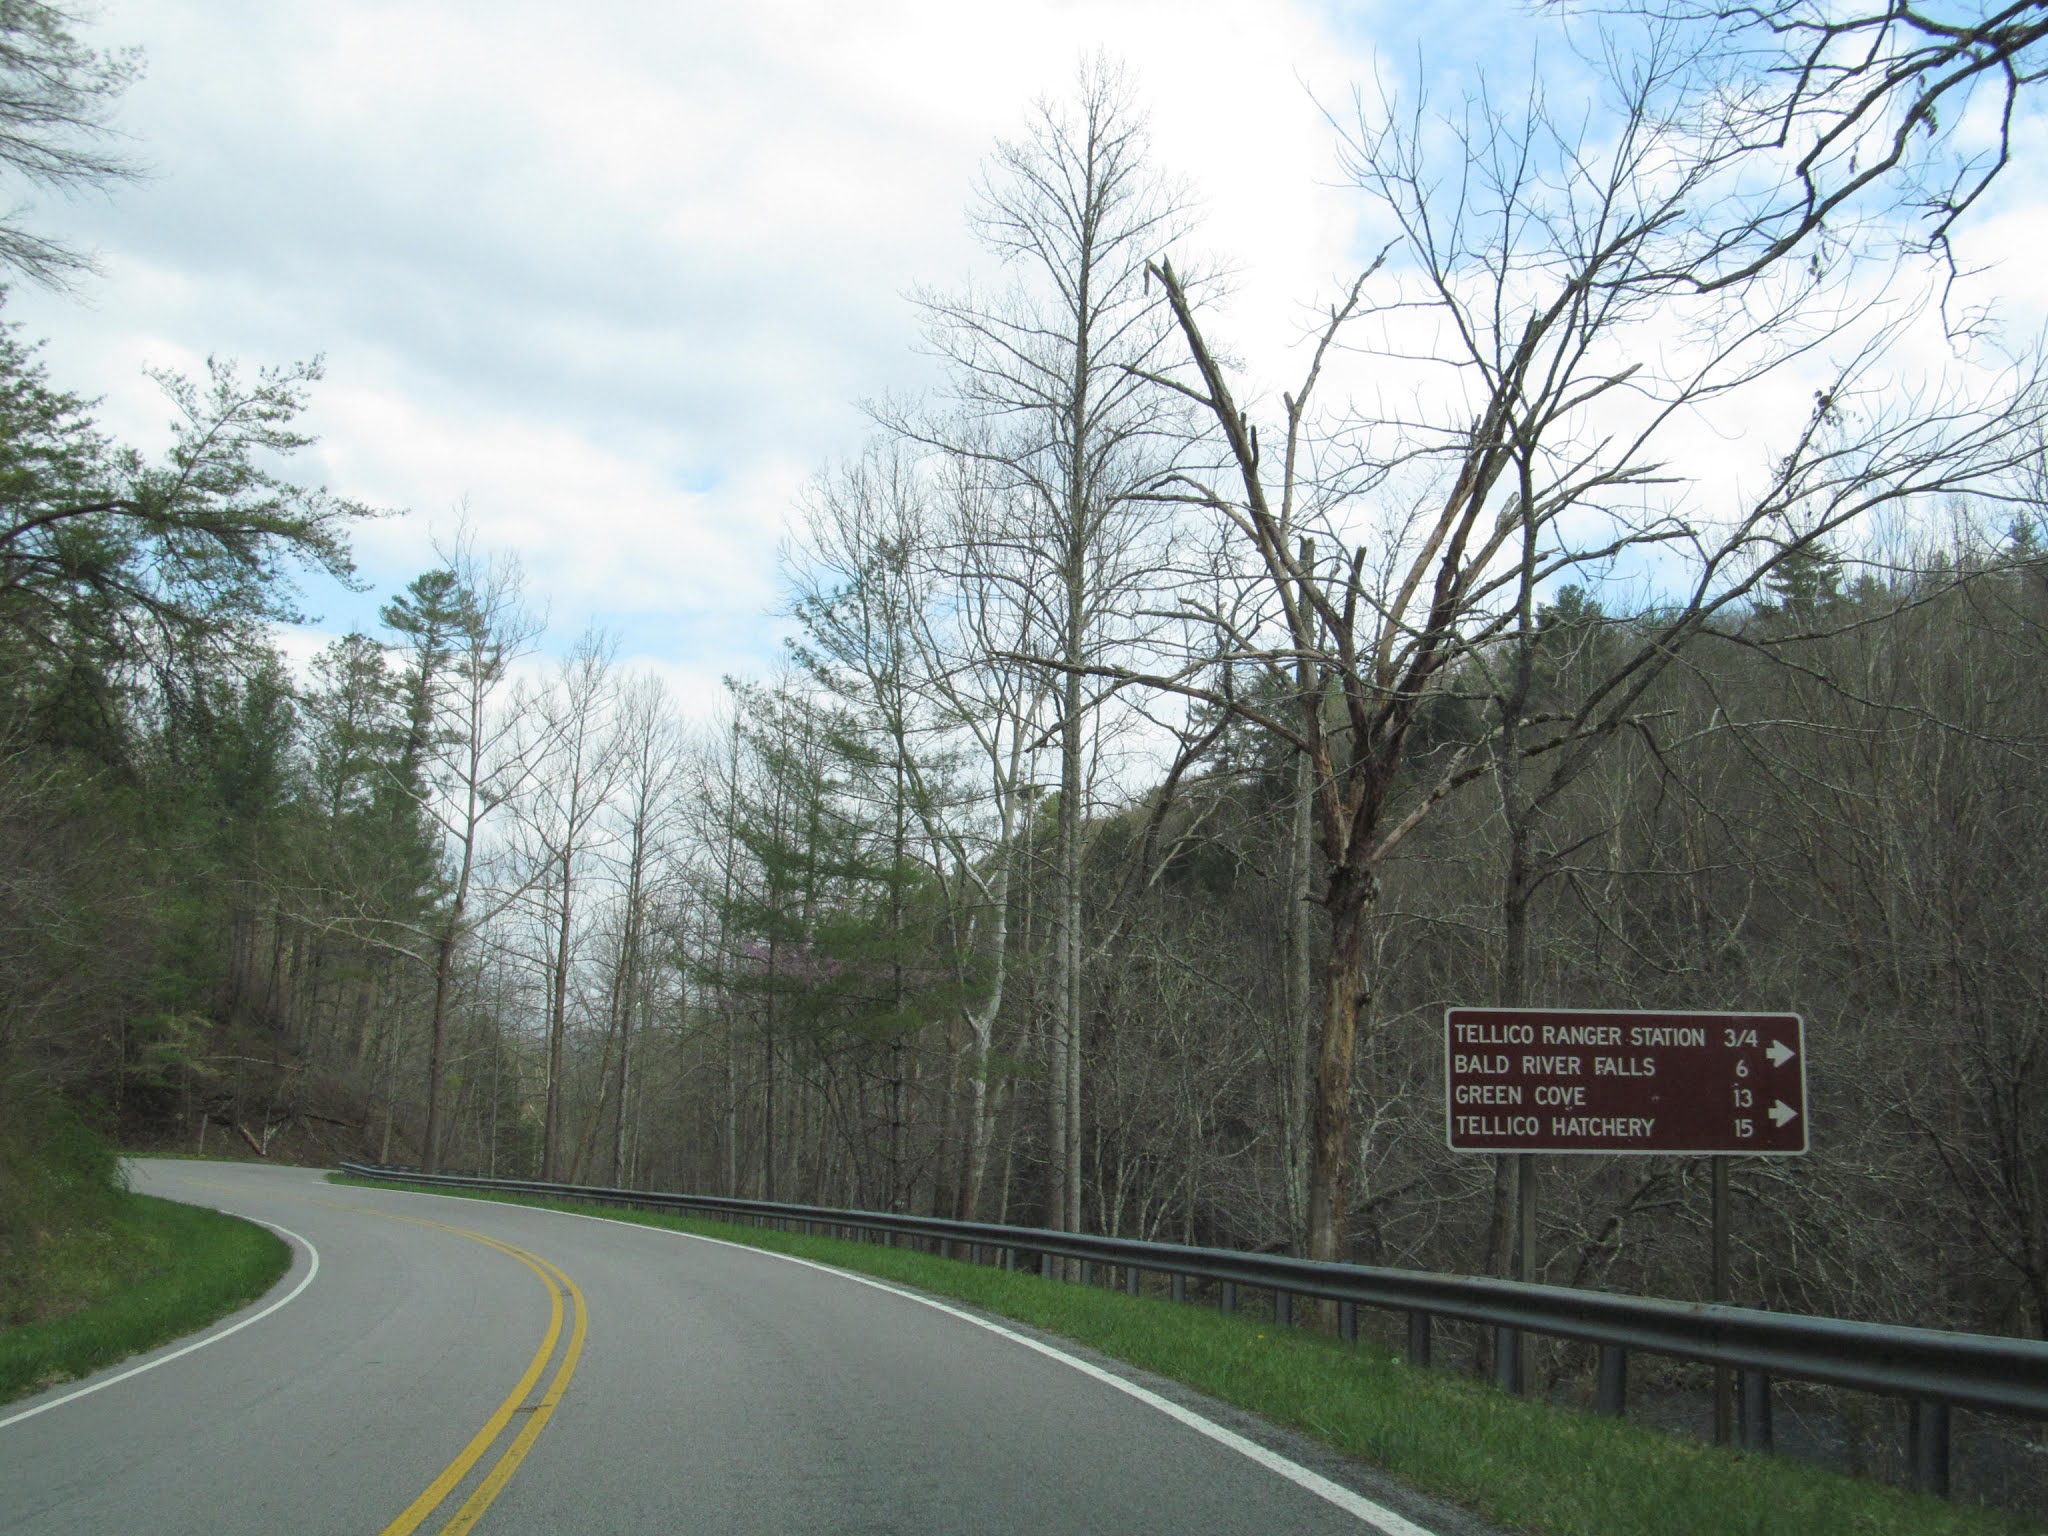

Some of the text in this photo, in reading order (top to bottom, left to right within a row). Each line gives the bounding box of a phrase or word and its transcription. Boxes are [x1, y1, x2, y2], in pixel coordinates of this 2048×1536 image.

[1455, 1025, 1757, 1047] TELLICO RANGER STATION 3/4
[1455, 1055, 1748, 1077] BALD RIVER FALLS 6
[1456, 1086, 1752, 1107] GREEN COVE 13
[1457, 1116, 1752, 1137] TELLICO HATCHERY 15
